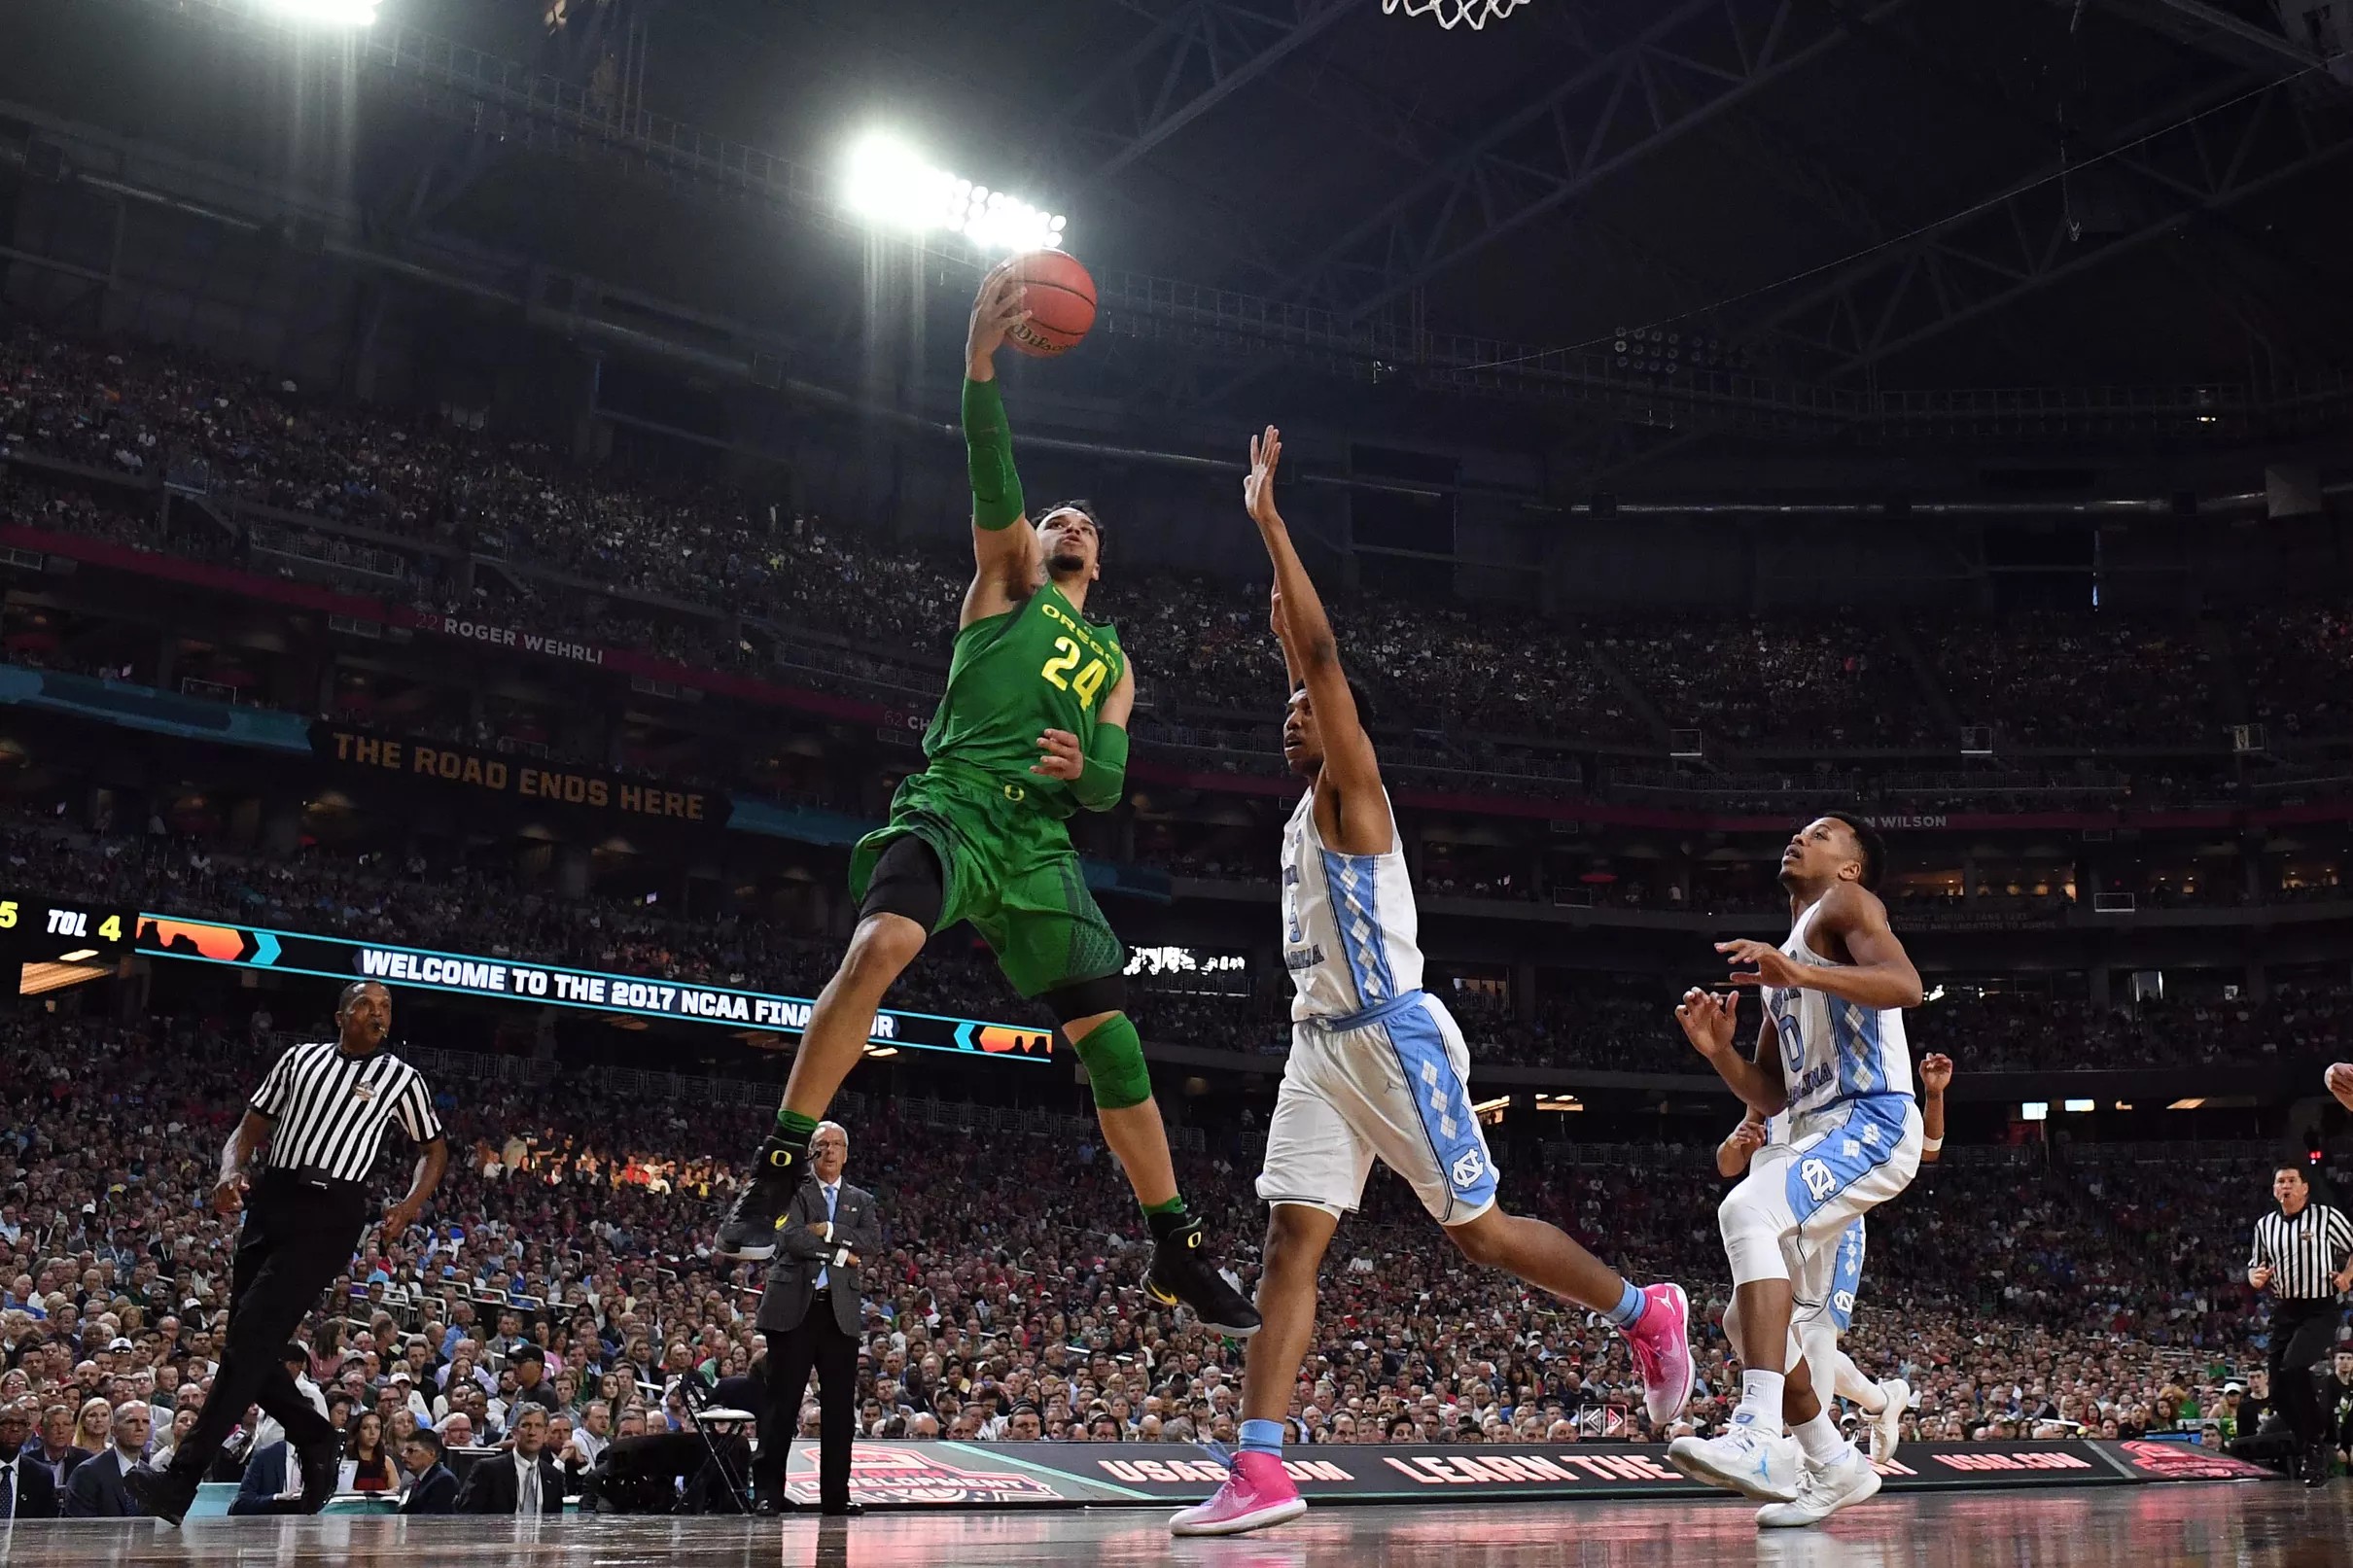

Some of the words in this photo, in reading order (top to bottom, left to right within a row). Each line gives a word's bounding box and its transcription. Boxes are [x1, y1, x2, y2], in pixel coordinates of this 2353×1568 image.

[443, 617, 517, 646] ROGER
[523, 634, 603, 665] WEHRLI
[1041, 636, 1107, 712] 24
[333, 732, 401, 770] THE
[413, 746, 508, 790] ROAD
[518, 768, 609, 808] ENDS
[619, 784, 705, 820] HERE
[1880, 816, 1947, 828] WILSON
[47, 909, 88, 937] TOL
[98, 915, 123, 942] 4
[363, 949, 507, 991] WELCOME
[512, 969, 547, 995] TO
[554, 974, 606, 1002] THE
[612, 983, 676, 1011] 2017
[681, 990, 750, 1021] NCAA
[755, 999, 813, 1028] FINA
[1382, 1455, 1580, 1483] LEARN
[1559, 1454, 1684, 1480] THE
